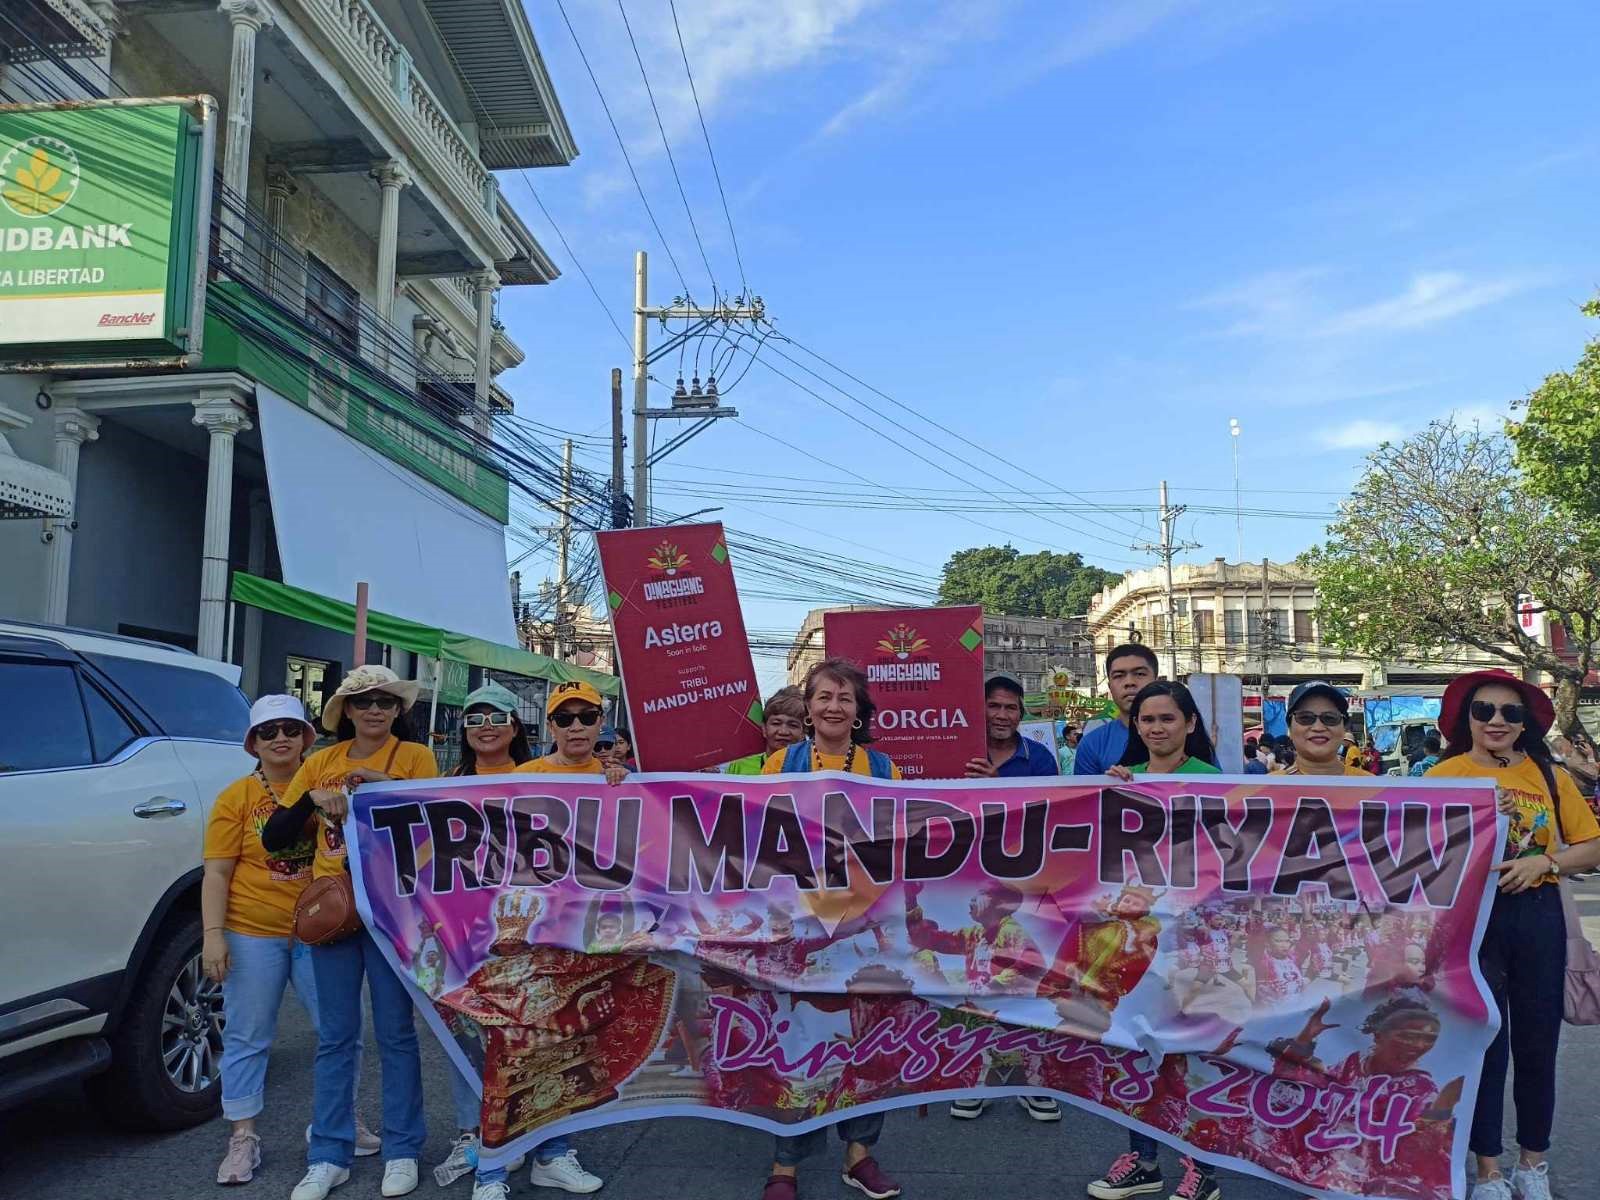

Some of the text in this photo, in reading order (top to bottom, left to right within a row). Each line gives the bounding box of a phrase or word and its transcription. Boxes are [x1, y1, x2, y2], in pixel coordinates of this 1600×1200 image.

[0, 223, 134, 252] DBANK
[0, 267, 105, 287] A LIBERTAD
[98, 312, 156, 325] BancNet
[645, 620, 722, 649] Asterra
[867, 663, 941, 682] DINAGYANG
[558, 681, 582, 693] CAT
[680, 677, 708, 689] TRIBU
[879, 681, 928, 692] FESTIVAL
[643, 679, 748, 714] MANDU-RIYAW
[897, 765, 924, 775] RIBU
[370, 788, 1475, 909] TRIBU MANDU-RIYAW
[709, 994, 1416, 1165] Dinagyang 2024
